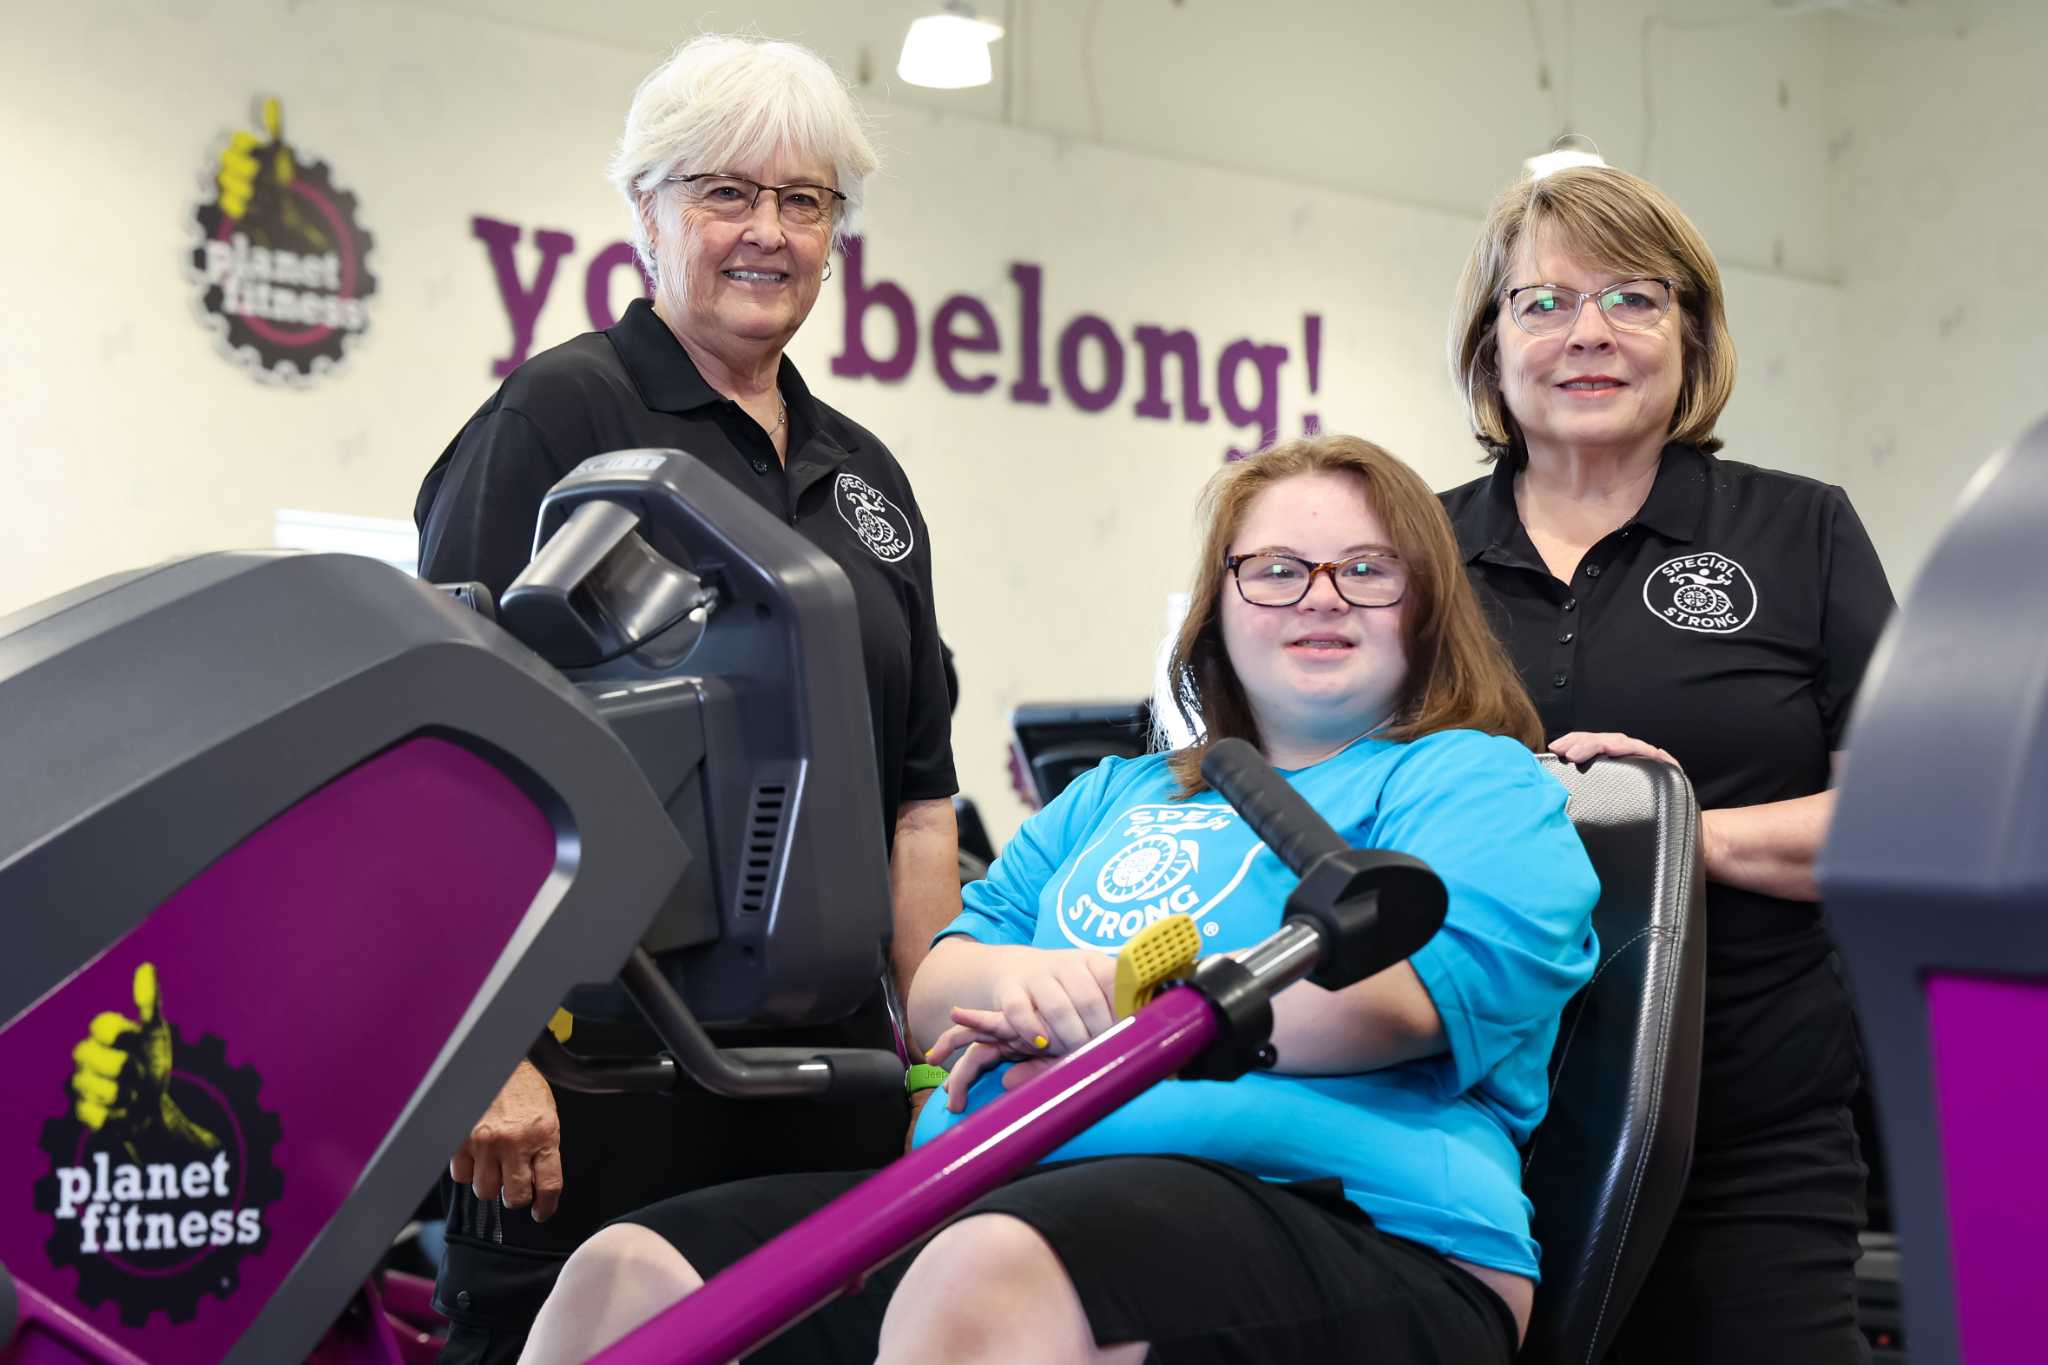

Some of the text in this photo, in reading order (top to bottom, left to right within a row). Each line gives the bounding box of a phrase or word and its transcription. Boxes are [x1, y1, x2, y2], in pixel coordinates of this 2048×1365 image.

[206, 232, 341, 291] planet
[222, 274, 367, 331] fitness
[471, 215, 1322, 464] yo belong!
[840, 477, 885, 506] SPECIAL
[857, 526, 906, 556] STRONG
[1662, 557, 1736, 578] SPECIAL
[1664, 607, 1740, 628] STRONG
[1068, 884, 1200, 939] STRONG
[55, 1150, 231, 1219] planet
[79, 1202, 262, 1254] fitness
